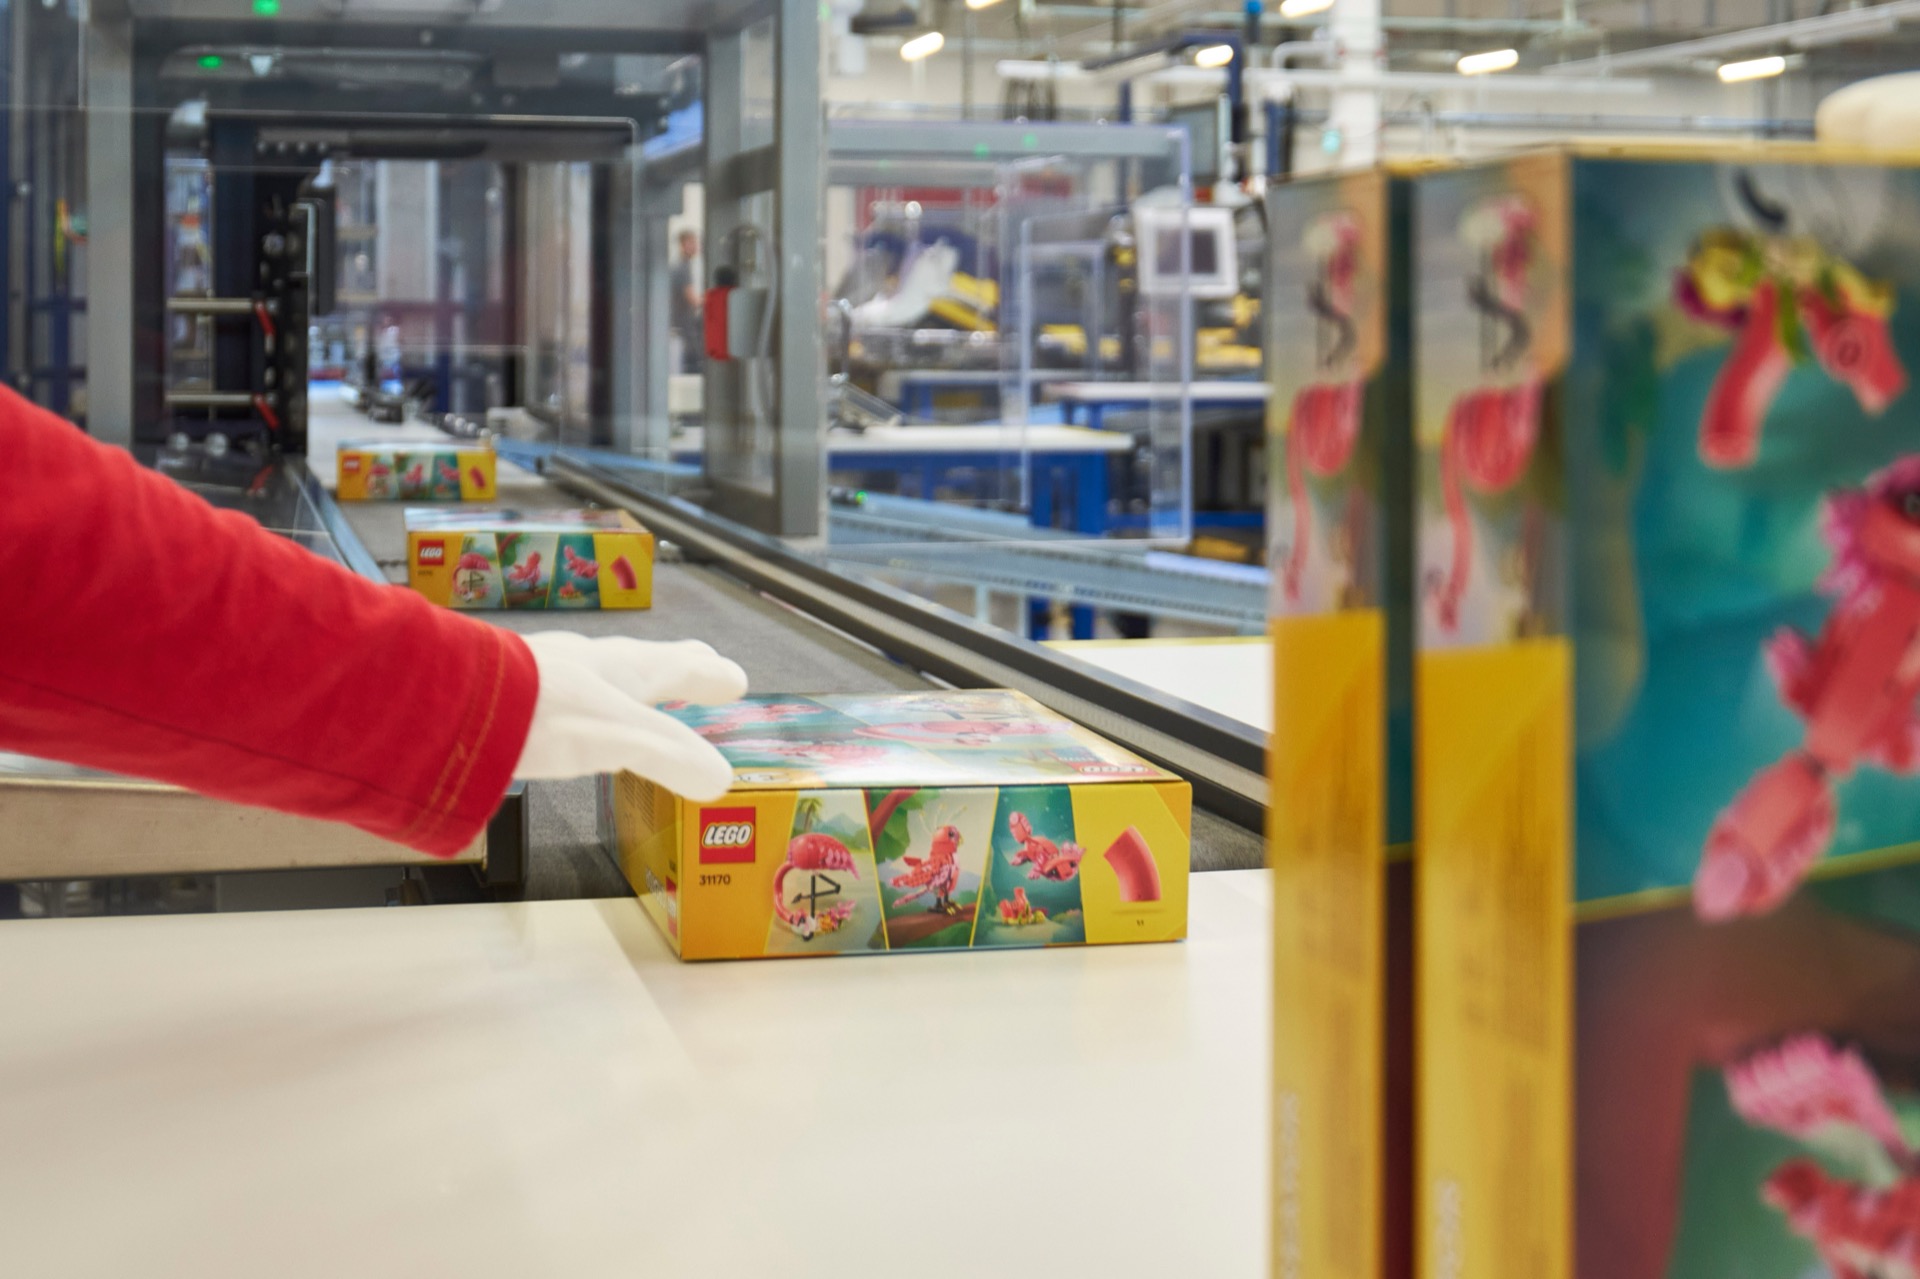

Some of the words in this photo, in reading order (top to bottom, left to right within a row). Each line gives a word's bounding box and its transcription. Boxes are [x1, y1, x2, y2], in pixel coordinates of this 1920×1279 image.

[420, 547, 443, 558] LEGO
[702, 823, 753, 847] LEGO
[699, 874, 731, 886] 31170
